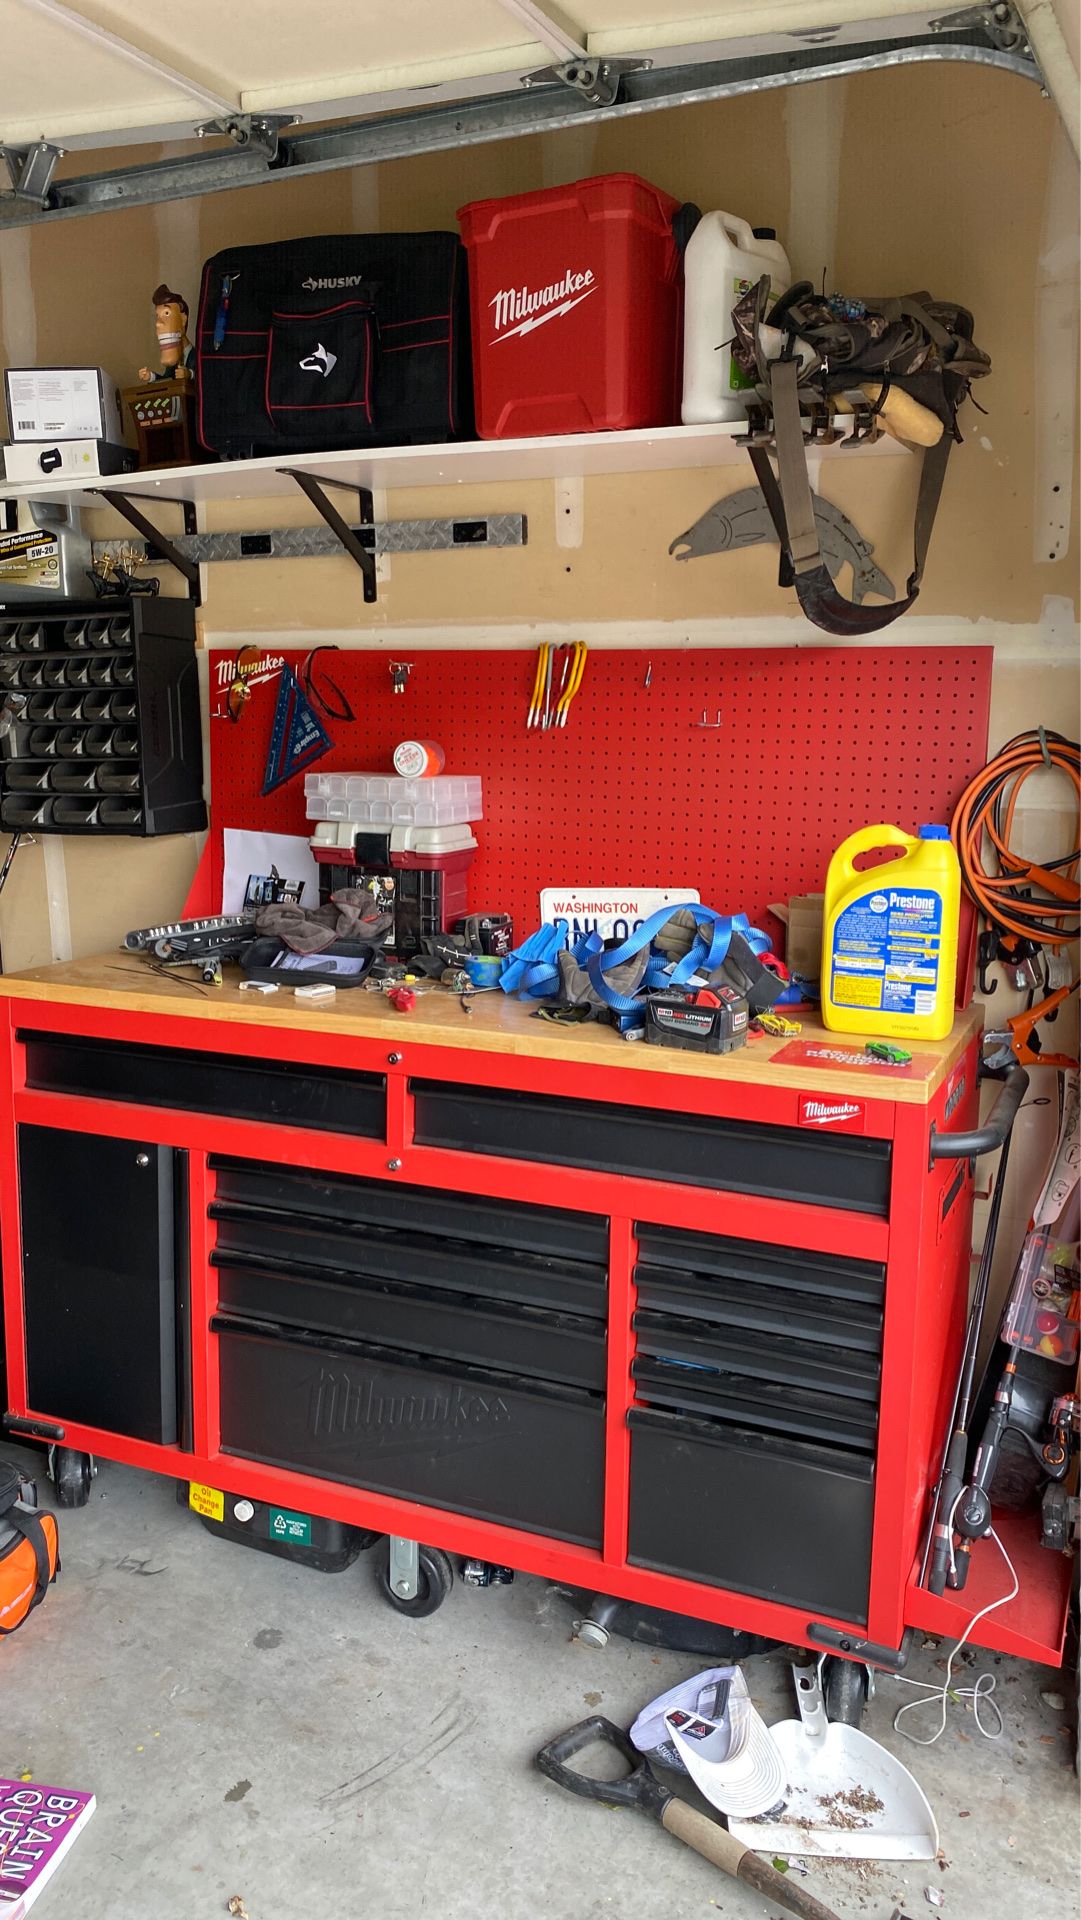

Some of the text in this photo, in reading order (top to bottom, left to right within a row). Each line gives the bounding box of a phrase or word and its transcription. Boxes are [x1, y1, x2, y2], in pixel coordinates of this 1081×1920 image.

[318, 275, 362, 289] HUSKY
[488, 269, 595, 330] Milwaukee
[11, 532, 44, 545] Performance
[31, 546, 54, 558] 5W-20
[553, 902, 638, 914] WASHINGTON
[890, 892, 936, 910] Prestone
[803, 1101, 861, 1118] Milwaukee
[306, 1366, 512, 1436] Milwaukee
[201, 1487, 211, 1498] Oil
[192, 1493, 220, 1510] Change
[199, 1503, 213, 1516] Pan
[2, 1795, 79, 1880] BRAIN
